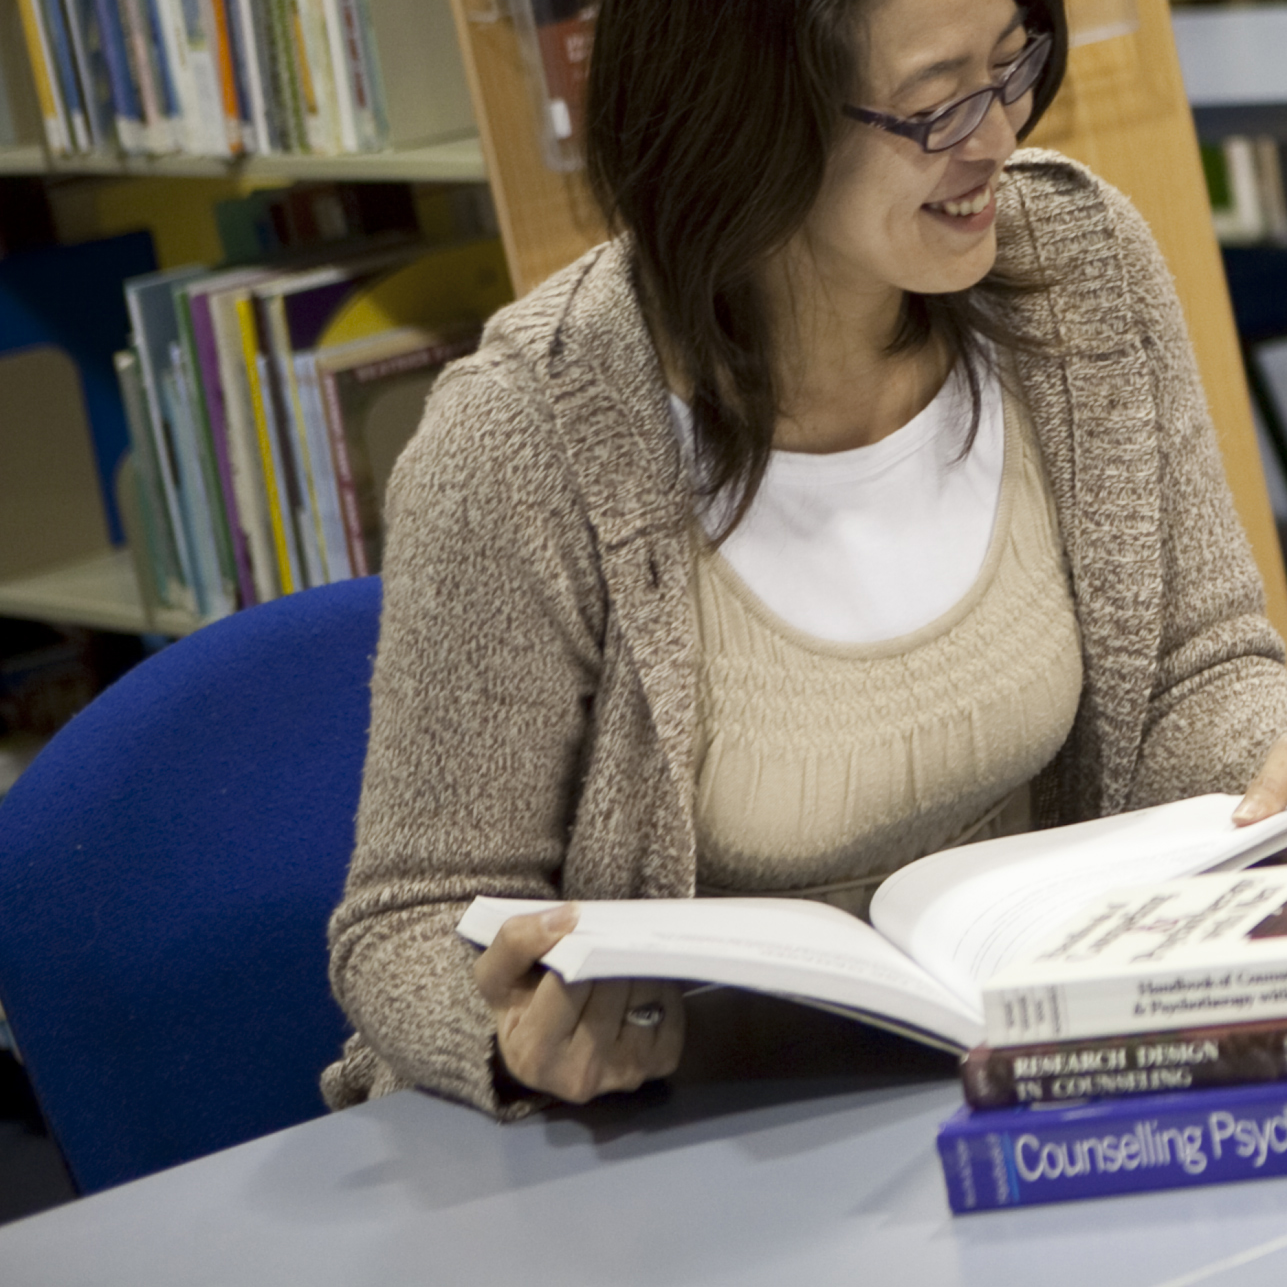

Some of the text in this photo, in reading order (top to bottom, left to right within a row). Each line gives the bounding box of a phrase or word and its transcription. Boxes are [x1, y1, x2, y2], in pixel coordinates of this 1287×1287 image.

[1013, 1039, 1220, 1079] RESEARCH DESIGN
[1016, 1067, 1193, 1101] IN COUNSELING
[1014, 1118, 1208, 1183] Counselling
